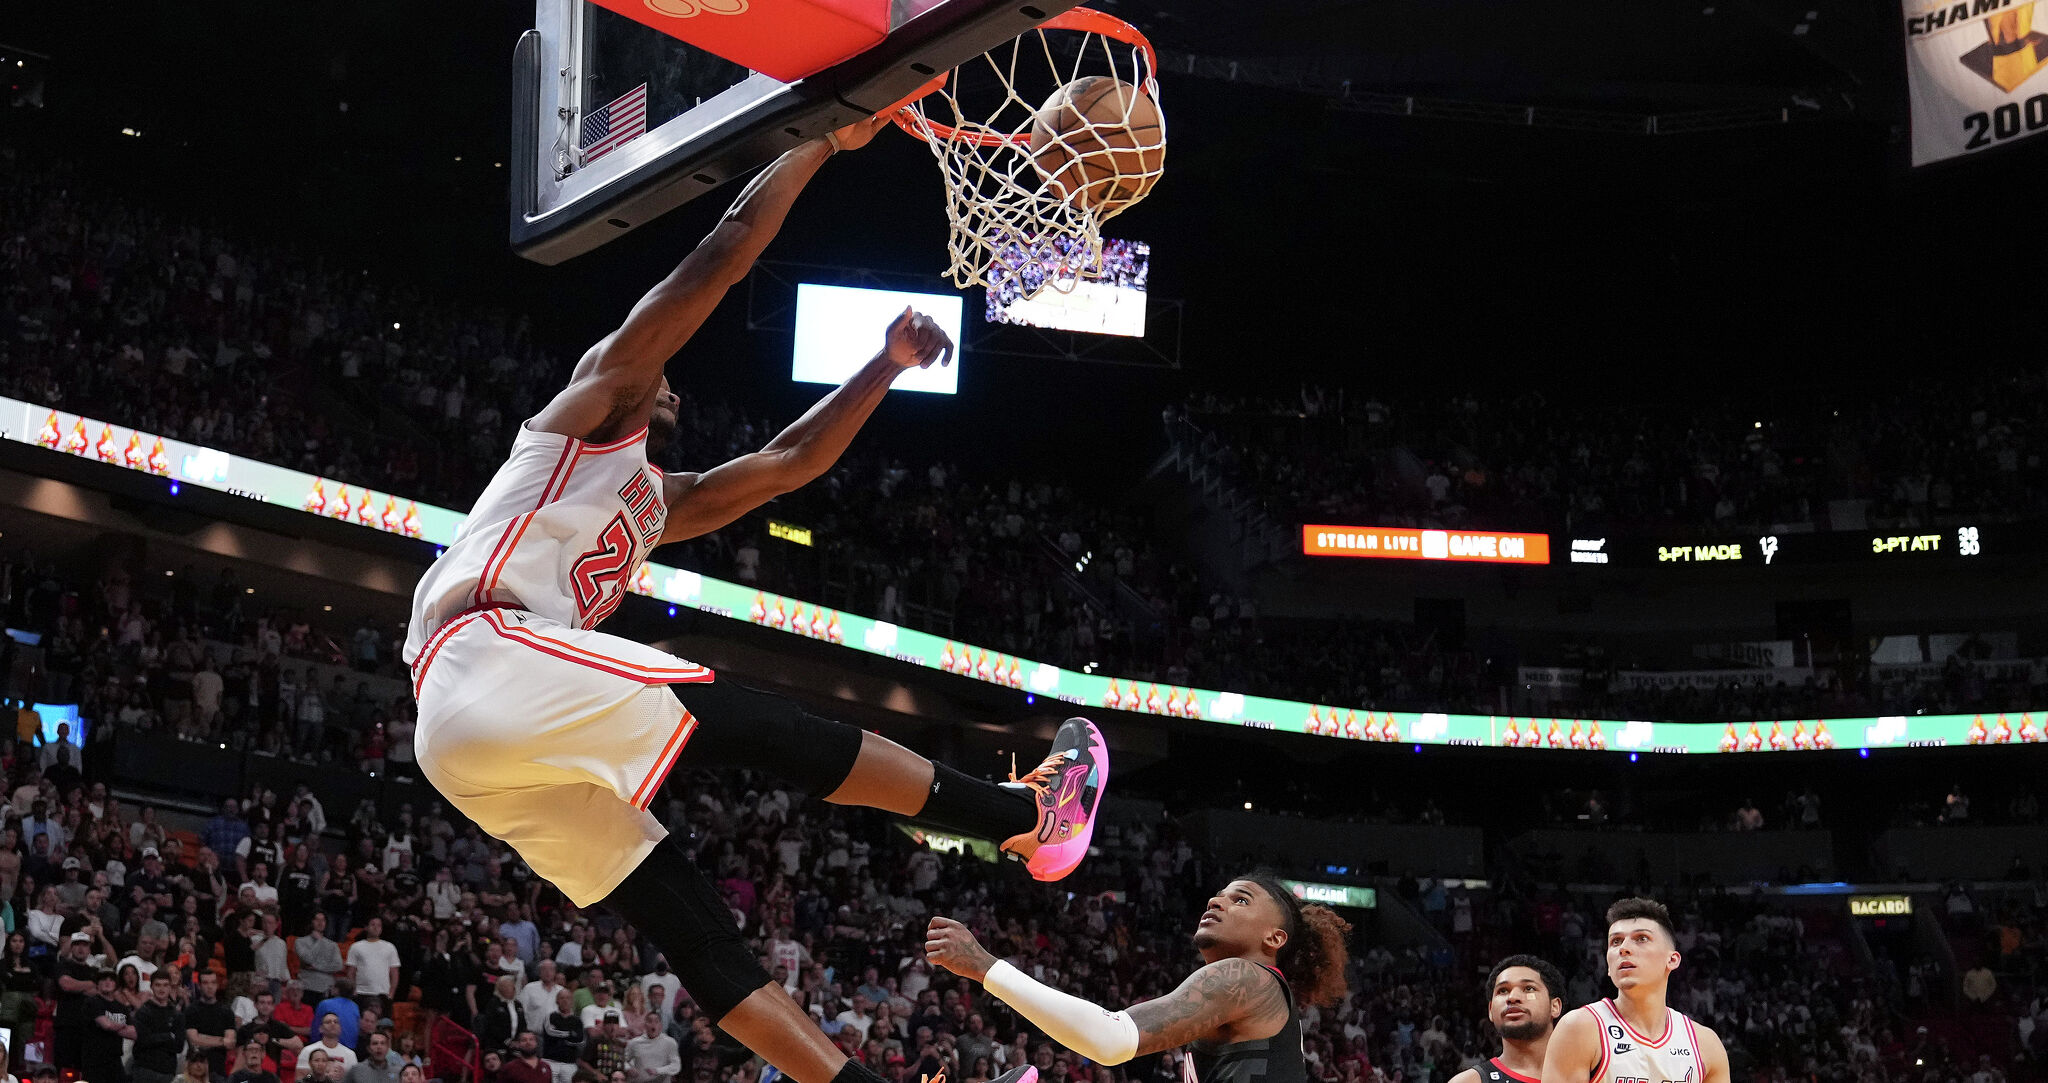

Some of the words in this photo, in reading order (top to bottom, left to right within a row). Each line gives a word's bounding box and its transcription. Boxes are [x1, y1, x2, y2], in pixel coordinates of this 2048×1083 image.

[1963, 93, 2048, 150] 200
[617, 467, 666, 549] HE
[1317, 532, 1378, 549] STREAM
[1383, 535, 1419, 551] LIVE
[1449, 534, 1497, 557] GAME
[1498, 537, 1525, 558] ON
[1658, 546, 1693, 562] 3-PT
[1694, 544, 1742, 561] MADE
[1759, 536, 1779, 550] 12
[1872, 537, 1909, 552] 3-PT
[1910, 535, 1942, 551] ATT
